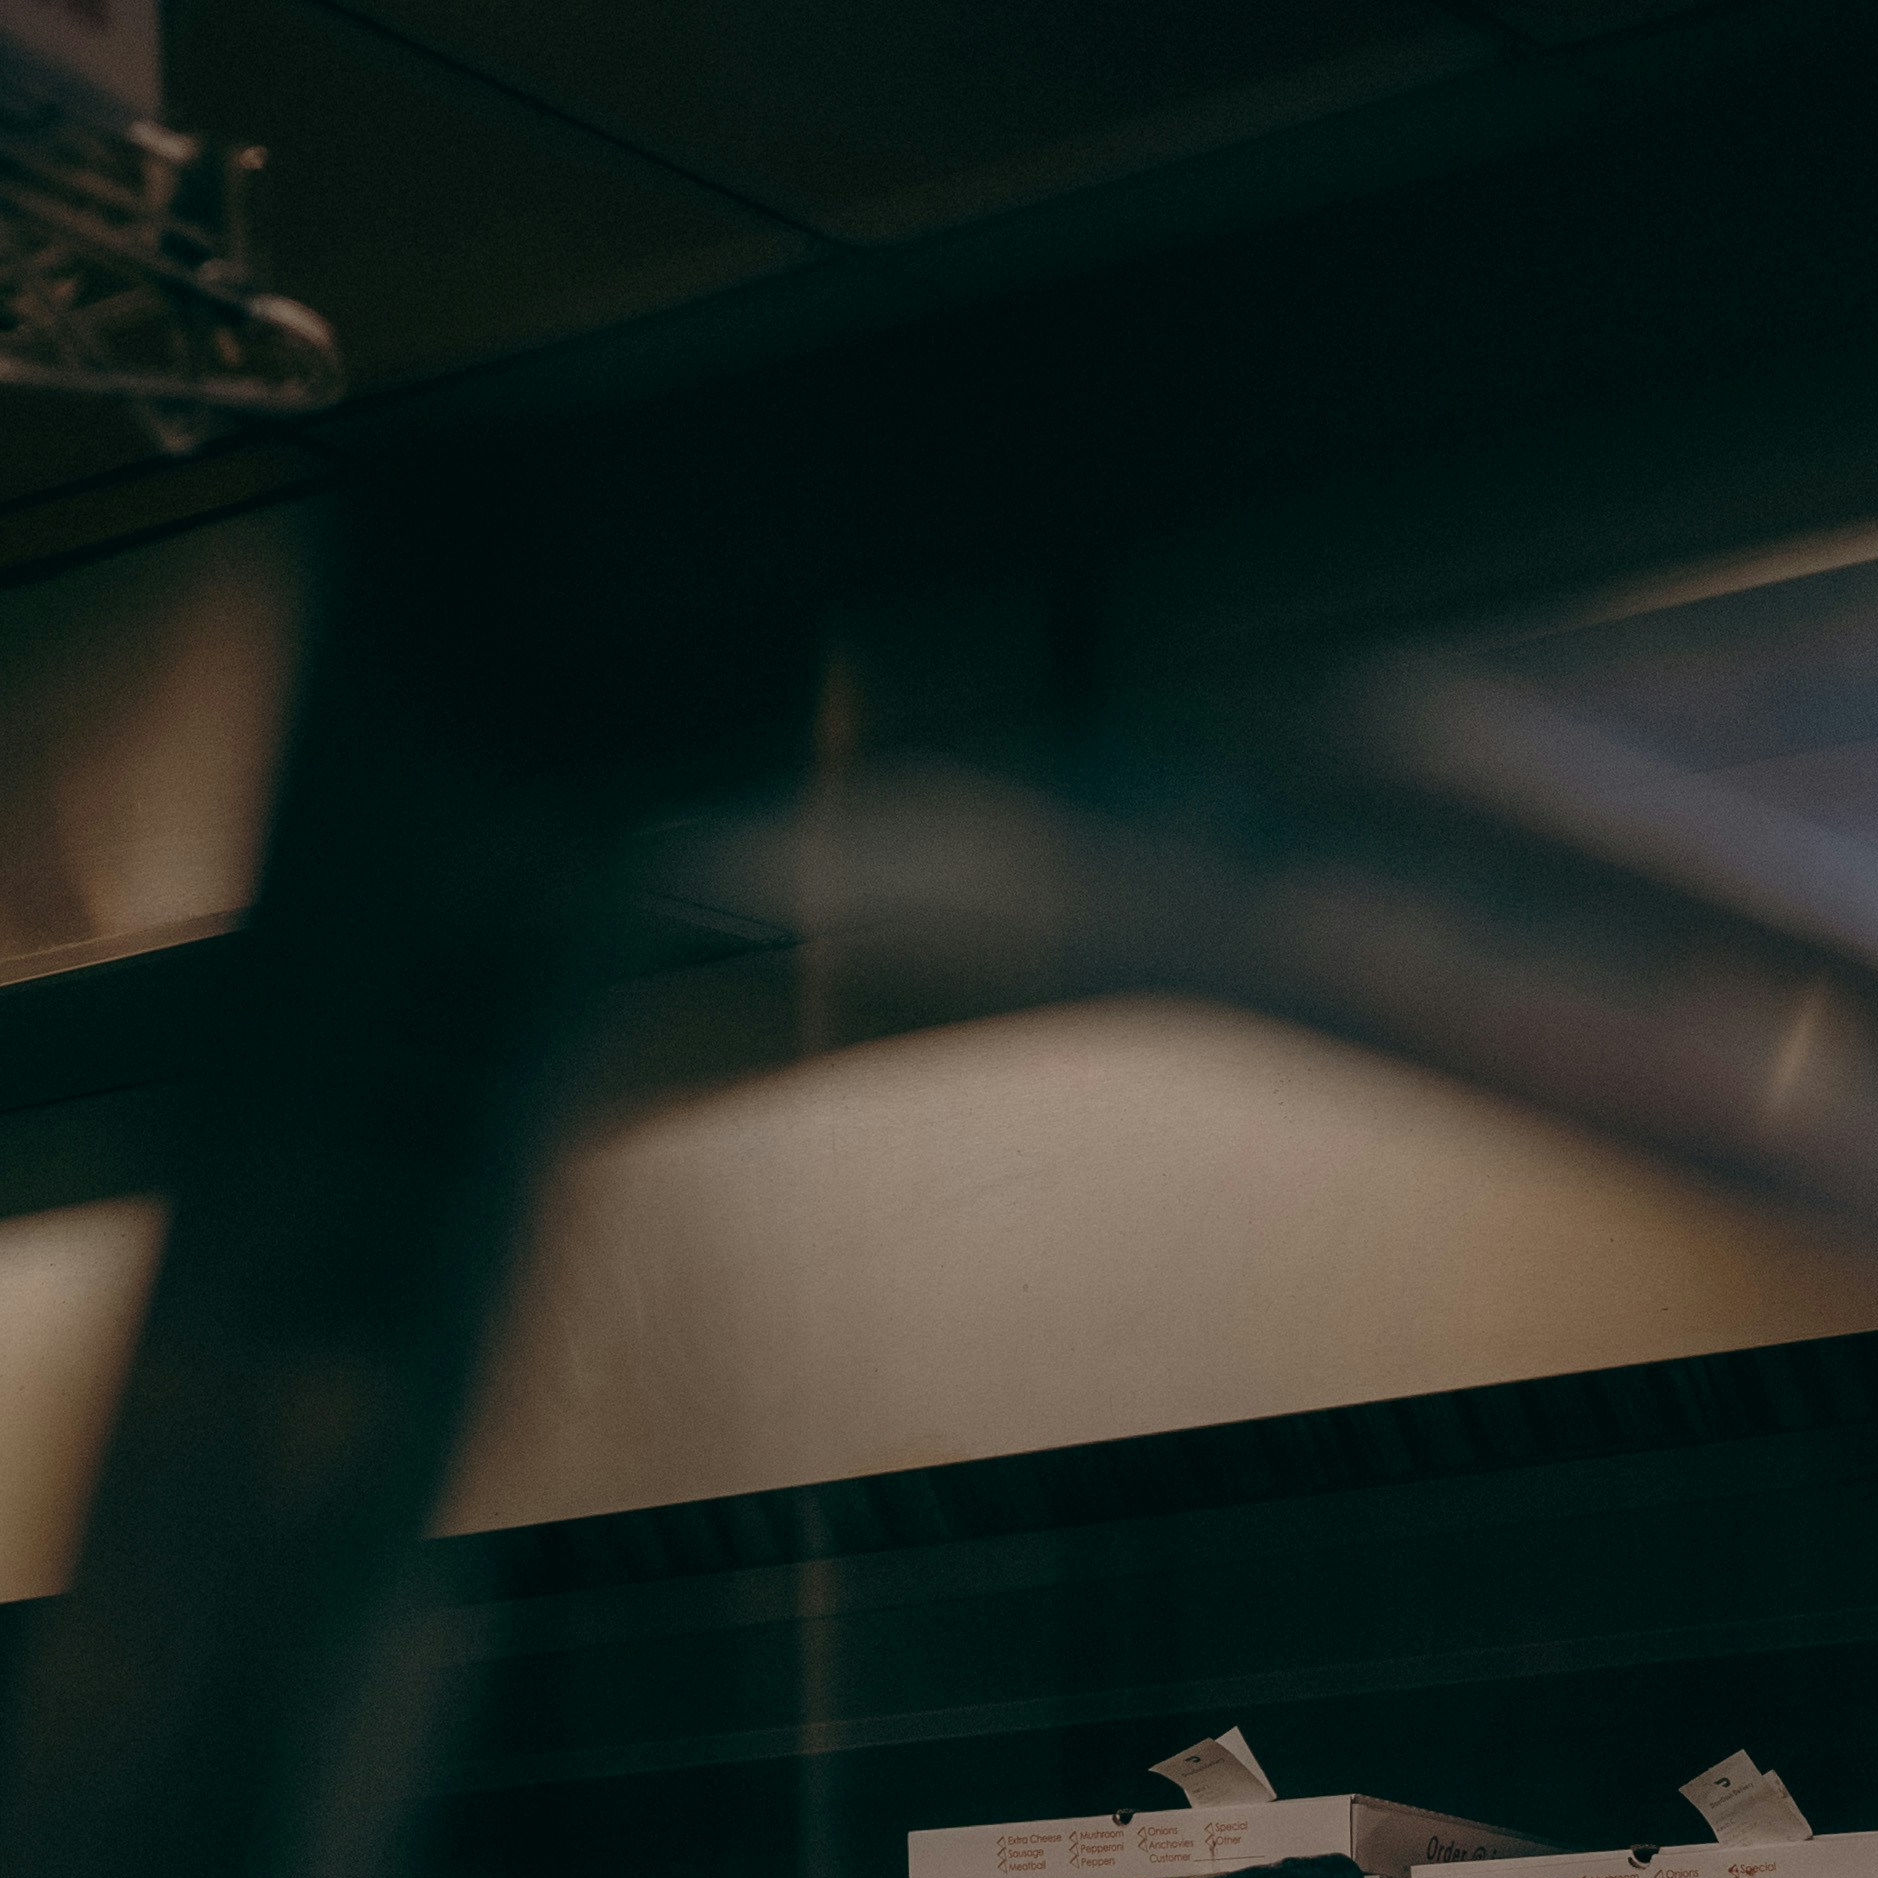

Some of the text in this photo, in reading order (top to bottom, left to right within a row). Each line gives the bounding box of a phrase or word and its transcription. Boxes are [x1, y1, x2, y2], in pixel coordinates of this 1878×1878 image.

[1080, 1828, 1124, 1841] Mushroom
[1148, 1826, 1178, 1837] Onions
[1215, 1821, 1248, 1835] Special
[1007, 1832, 1062, 1846] Extra Cheese
[1149, 1838, 1194, 1850] Anchovies
[1217, 1835, 1242, 1846] Other
[1008, 1847, 1044, 1860] Sausage
[1081, 1842, 1124, 1856] Pepperoni
[1426, 1835, 1468, 1862] Order
[1149, 1852, 1191, 1864] Customer
[1009, 1859, 1046, 1872] Meatball
[1740, 1861, 1777, 1876] Special
